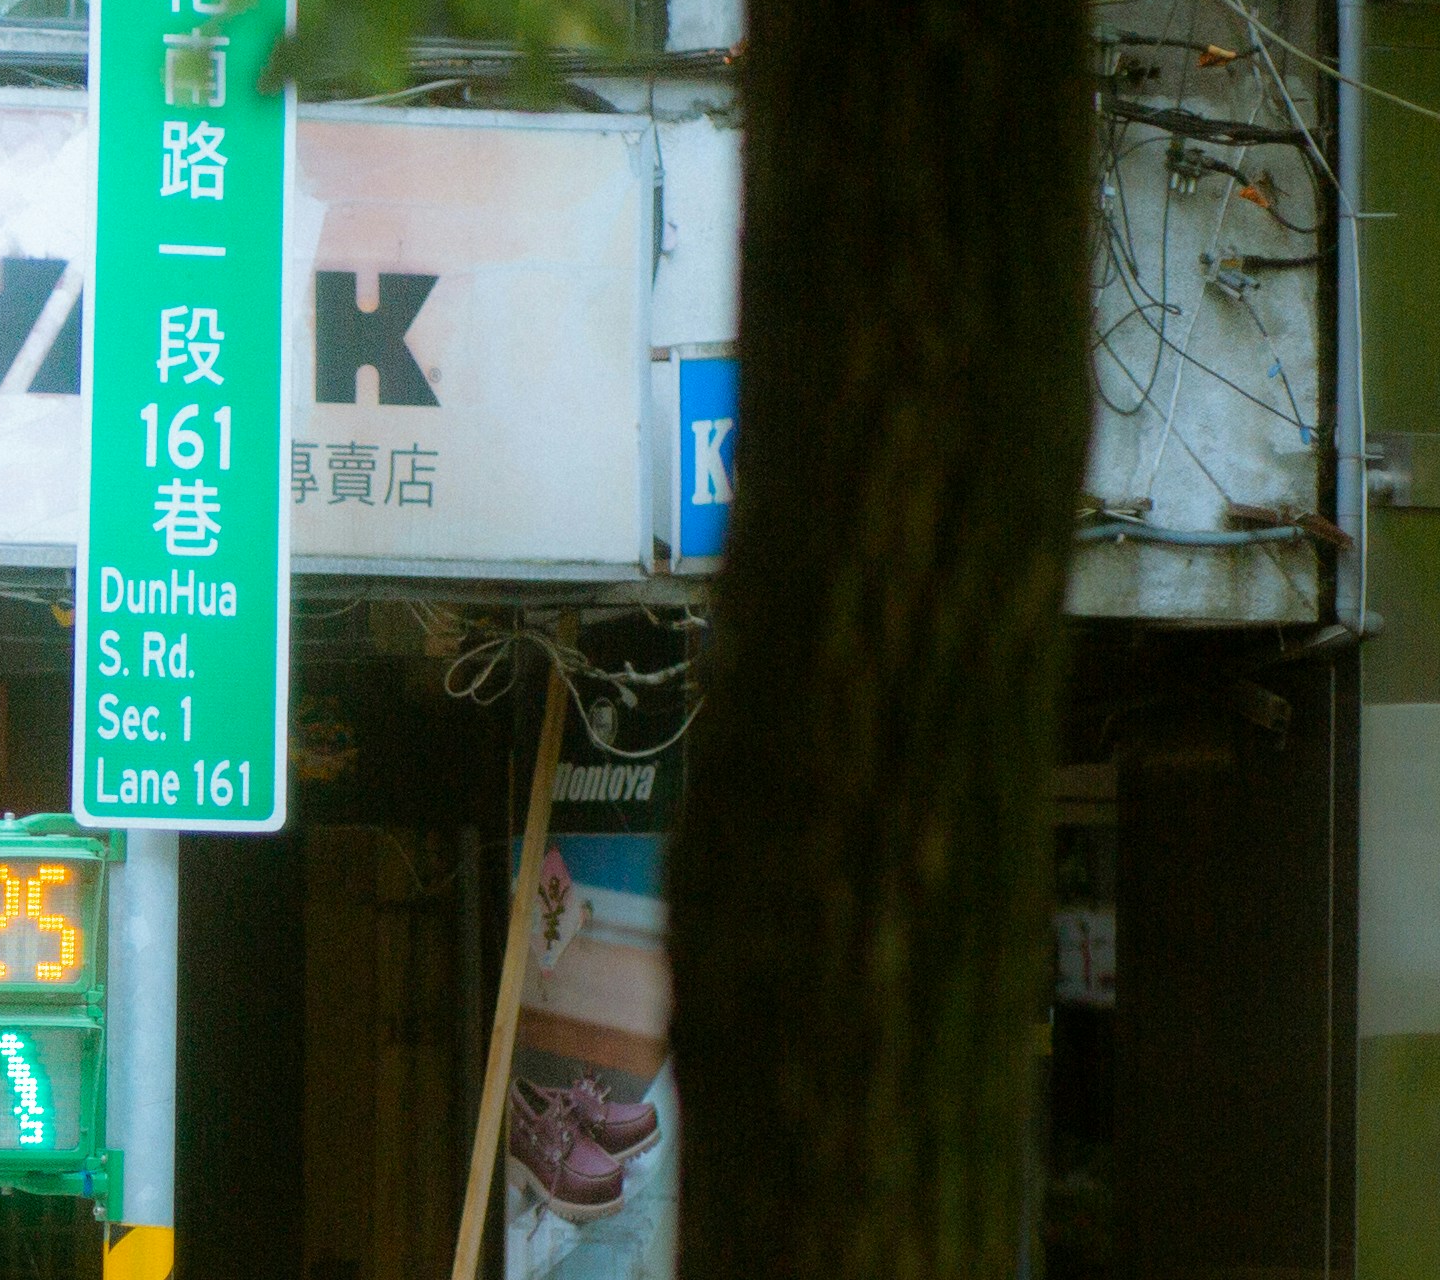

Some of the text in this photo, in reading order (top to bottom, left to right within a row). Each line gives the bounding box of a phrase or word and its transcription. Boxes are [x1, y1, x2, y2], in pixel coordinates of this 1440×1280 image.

[99, 565, 238, 618] DunHua
[98, 631, 195, 679] S. Rd.
[97, 693, 192, 743] Sec. 1
[96, 756, 251, 807] Lane 161
